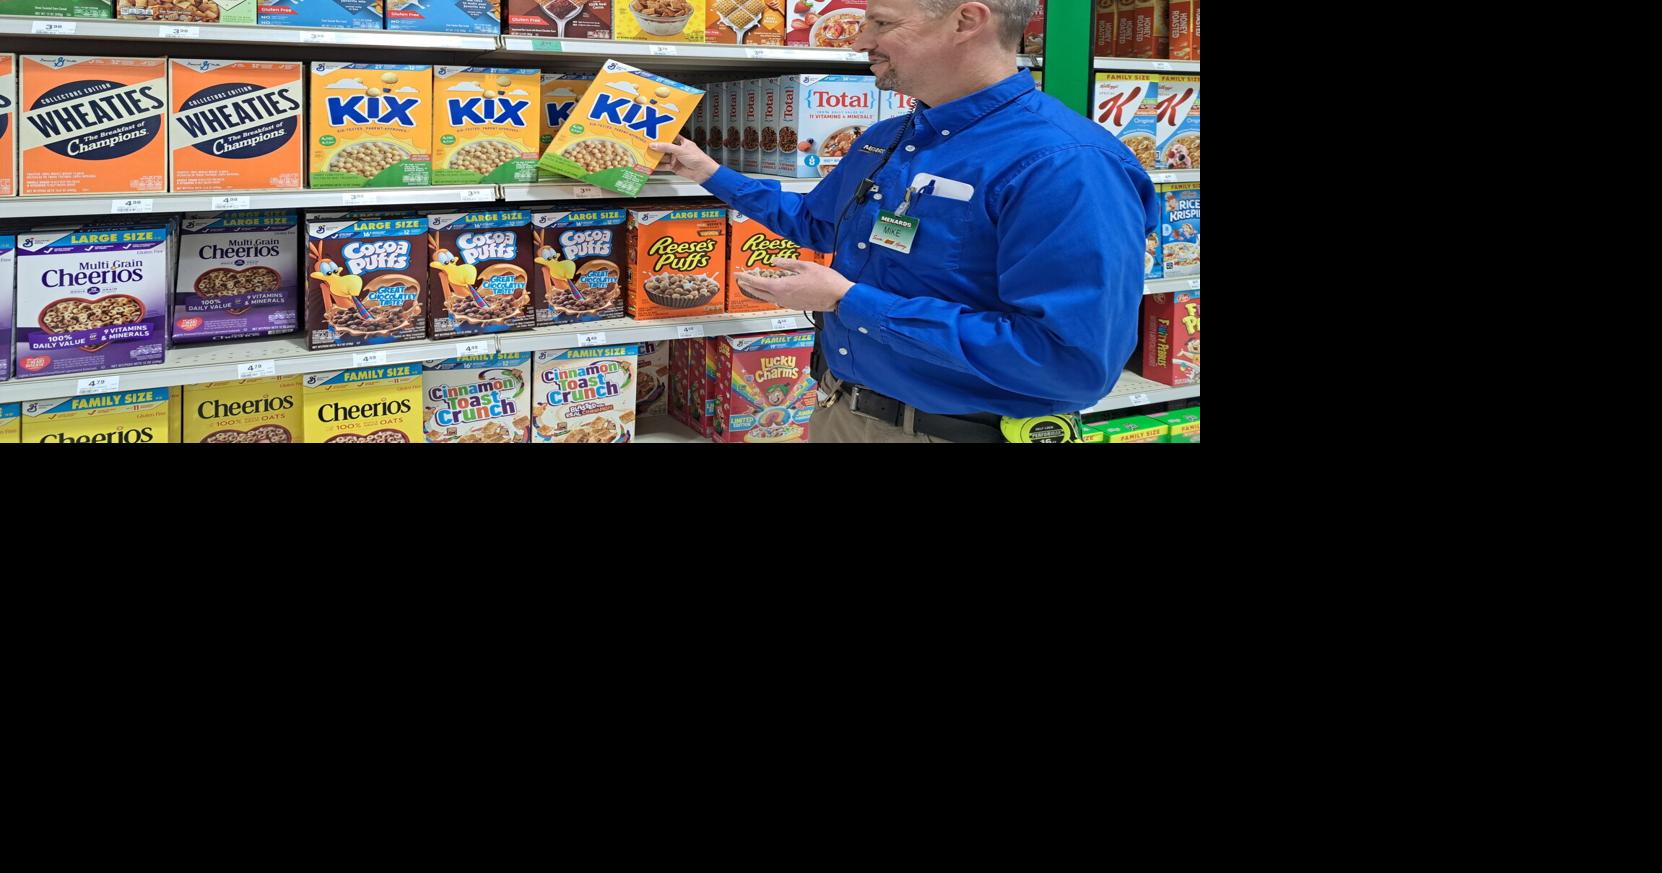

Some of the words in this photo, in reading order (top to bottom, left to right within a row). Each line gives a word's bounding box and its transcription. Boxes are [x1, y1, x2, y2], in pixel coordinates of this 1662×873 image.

[1171, 10, 1180, 38] ROASTED
[1180, 12, 1188, 34] HONEY
[40, 90, 82, 105] COLLECTORS
[83, 83, 112, 95] EDITION
[188, 92, 227, 107] COLLECTORS
[227, 86, 253, 97] EDITION
[813, 91, 870, 108] Total
[747, 92, 755, 119] Total
[765, 90, 773, 119] Total
[784, 89, 794, 118] Total
[1098, 86, 1142, 127] K
[27, 86, 164, 139] WHEATIES
[176, 88, 300, 139] WHEATIES
[84, 133, 98, 142] The
[100, 124, 136, 139] Breakfast
[136, 121, 145, 129] of
[227, 133, 241, 142] The
[242, 124, 275, 138] Breakfast
[275, 121, 283, 129] of
[1179, 199, 1200, 210] RICE
[223, 218, 260, 226] LARGE
[263, 217, 288, 225] SIZE
[465, 213, 498, 222] LARGE
[501, 212, 523, 220] SIZE
[568, 213, 597, 222] LARGE
[670, 211, 698, 219] LARGE
[701, 210, 720, 218] SIZE
[881, 215, 912, 228] MENARDS
[1170, 209, 1200, 223] KRISPI
[354, 222, 391, 230] LARGE
[395, 221, 419, 229] SIZE
[883, 226, 902, 238] MIKE
[71, 233, 117, 244] LARGE
[123, 231, 153, 241] SIZE
[228, 239, 253, 247] Multi
[255, 239, 279, 247] Grain
[458, 232, 515, 249] Cocoa
[561, 231, 611, 247] Cocoa
[648, 236, 717, 255] Reese's
[199, 243, 280, 260] Cheerios
[344, 241, 408, 260] Cocoa
[462, 243, 515, 265] Puffs
[564, 241, 611, 260] Puffs
[79, 260, 109, 271] Multi
[113, 259, 143, 269] Grain
[348, 253, 409, 275] Puffs
[654, 249, 712, 273] Puffs
[41, 266, 143, 288] Cheerios
[490, 275, 515, 283] GREAT
[378, 286, 405, 294] GREAT
[250, 297, 285, 305] MINERALS
[108, 331, 150, 340] MINERALS
[110, 325, 148, 333] VITAMINS
[33, 341, 58, 349] DAILY
[59, 339, 86, 347] VALUE
[761, 336, 792, 345] FAMILY
[497, 352, 520, 360] SIZE
[567, 349, 607, 359] FAMILY
[607, 347, 625, 356] SIZE
[760, 355, 797, 372] Lucky
[343, 370, 383, 382] FAMILY
[386, 367, 410, 378] SIZE
[559, 373, 607, 392] Toast
[755, 367, 800, 383] Charms
[71, 395, 123, 410] FAMILY
[125, 391, 153, 403] SIZE
[448, 389, 501, 411] Toast
[548, 381, 620, 406] Crunch
[198, 394, 294, 419] Cheerios
[318, 397, 411, 423] Cheerios
[436, 398, 516, 426] Crunch
[216, 419, 241, 427] 100%
[261, 413, 286, 421] OATS
[336, 423, 361, 431] 100%
[379, 417, 404, 425] OATS
[1120, 432, 1144, 441] FAMILY
